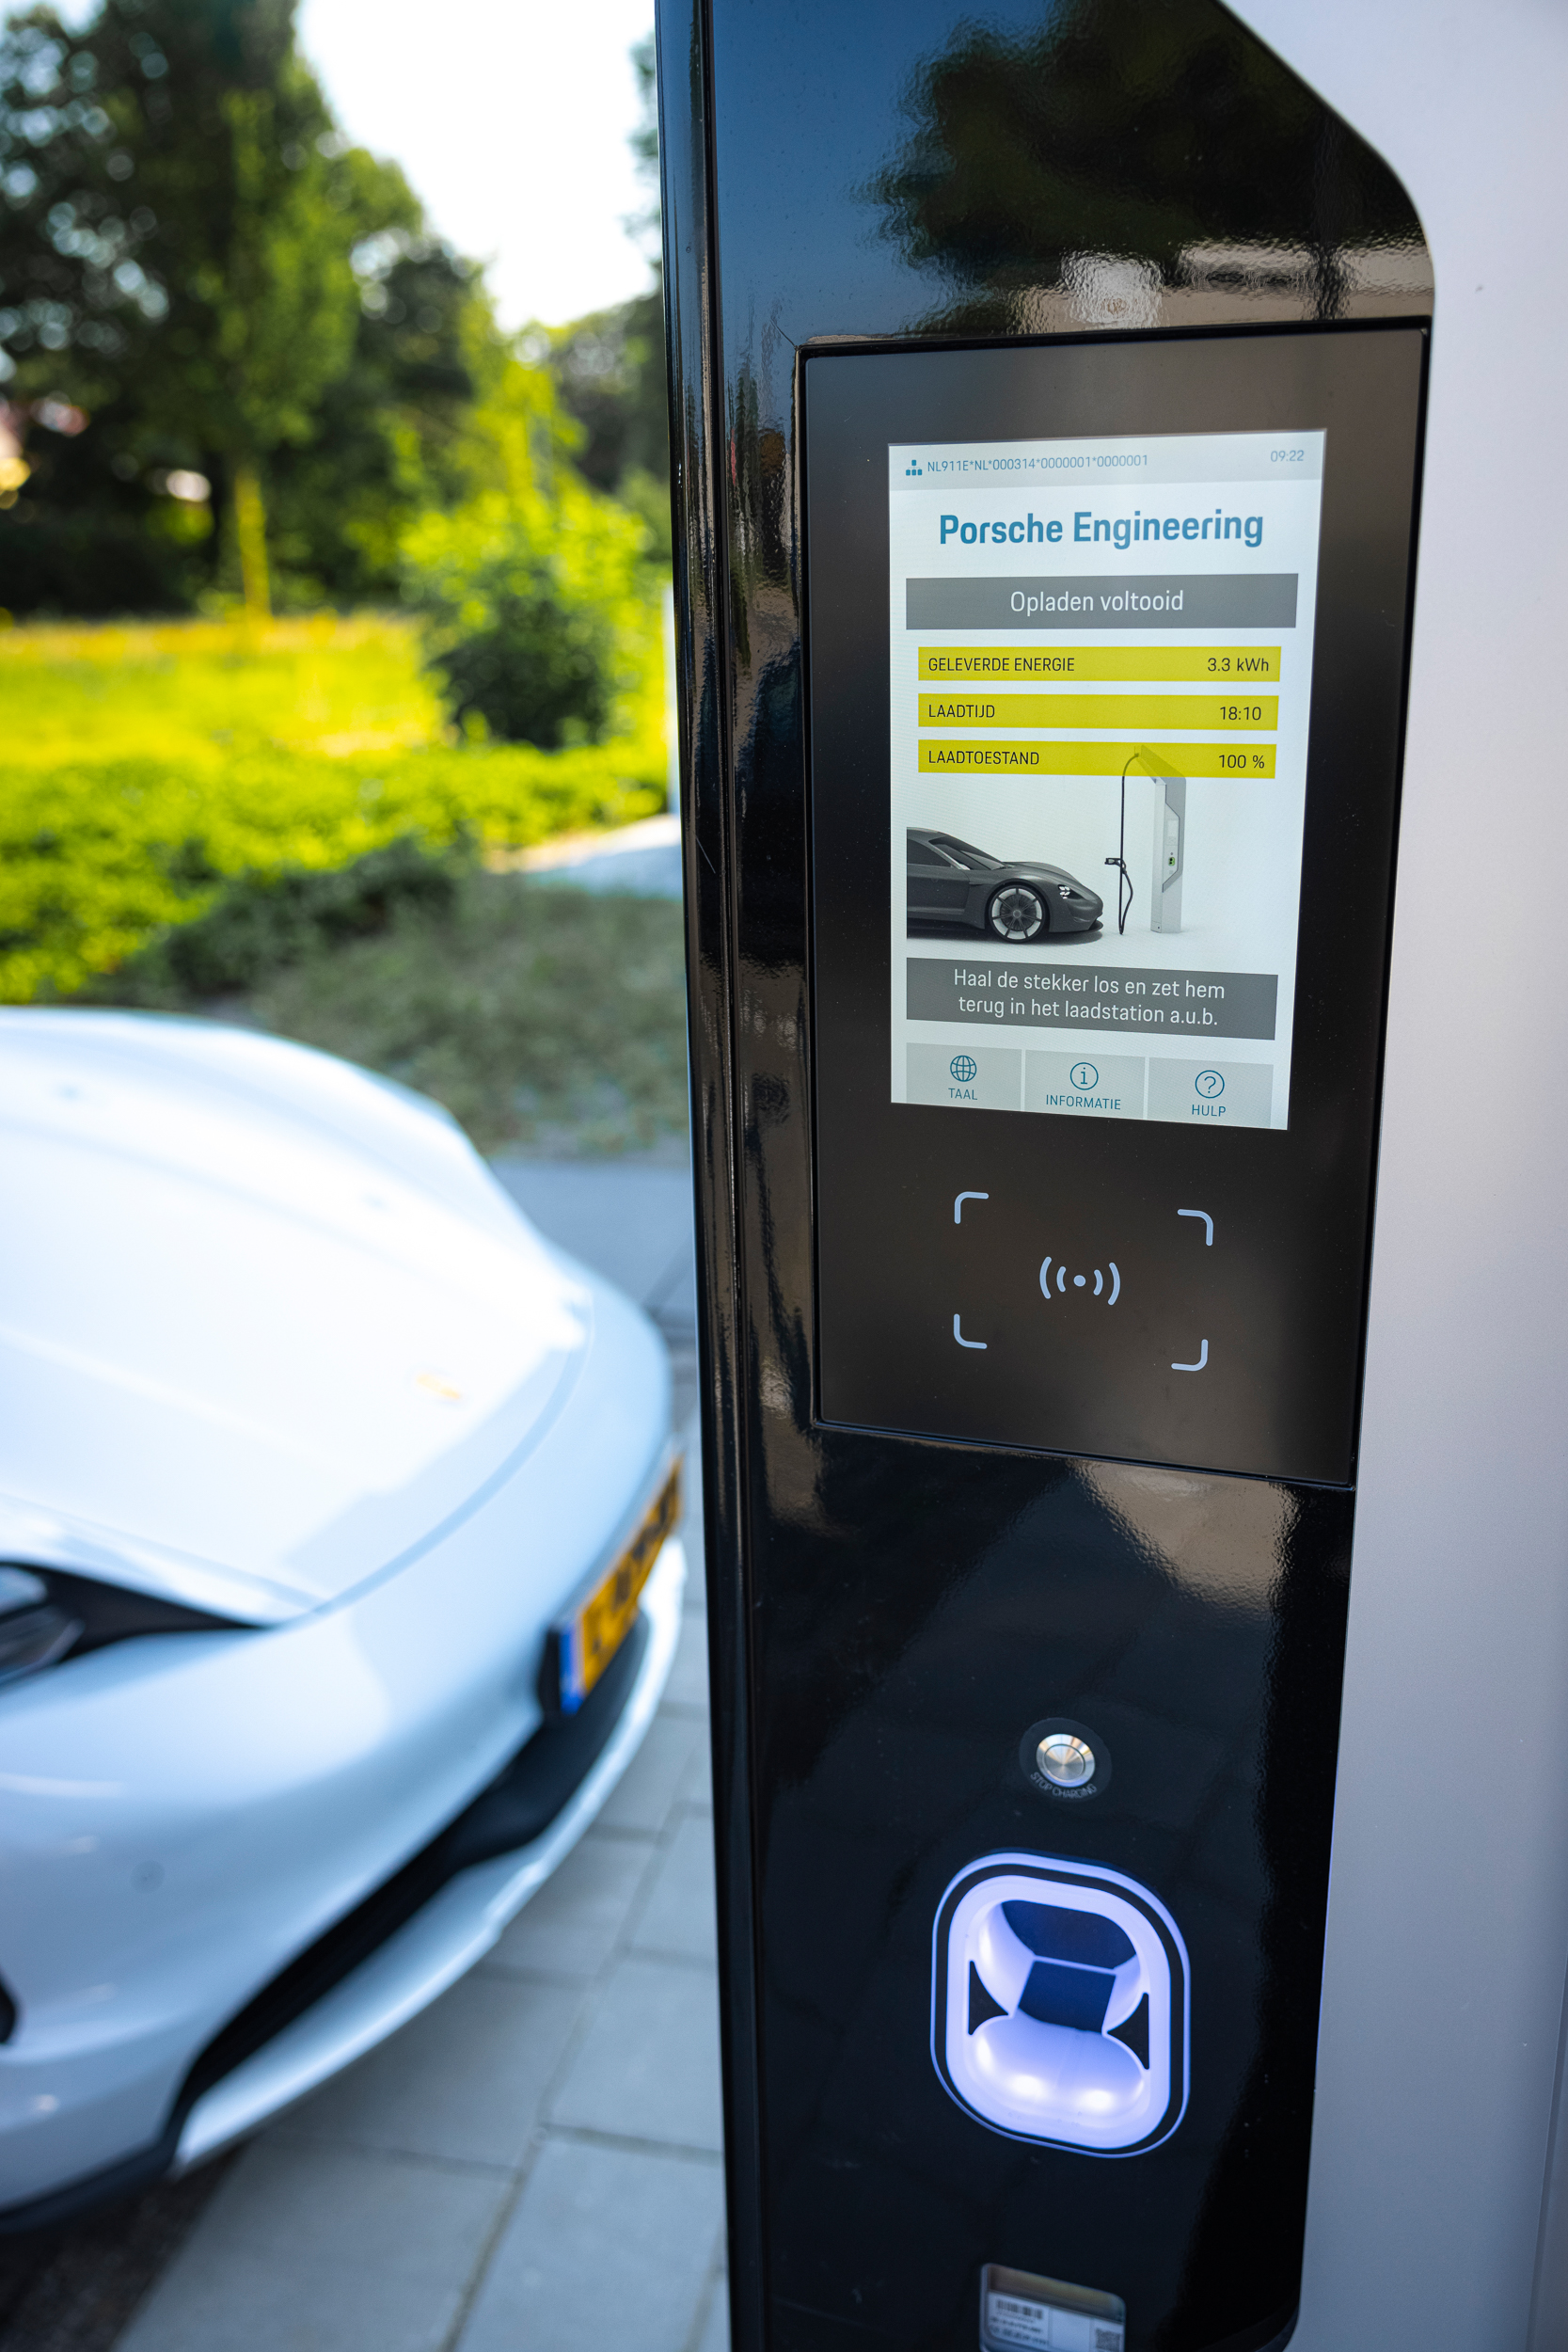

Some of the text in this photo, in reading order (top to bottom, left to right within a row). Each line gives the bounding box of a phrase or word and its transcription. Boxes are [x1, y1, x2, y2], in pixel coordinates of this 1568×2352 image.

[1270, 450, 1305, 463] 09:22
[940, 509, 1263, 549] Porsche Engineering
[1010, 590, 1184, 616] Opladen voltooid
[928, 658, 1270, 672] GELEVERDE ENERGIE 3.3 kWh
[928, 704, 1261, 720] LAADTIJD 18:10
[928, 750, 1265, 769] LAADTOESTAND 100 %
[954, 969, 1225, 999] Haal de stekker los en zet hem
[958, 996, 1218, 1025] terug in het laadstation a.u.b.
[948, 1087, 978, 1101] TAAL
[1045, 1094, 1121, 1110] INFORMATIE
[1191, 1104, 1227, 1117] HULP
[1030, 1772, 1097, 1799] STOP CHARGING
